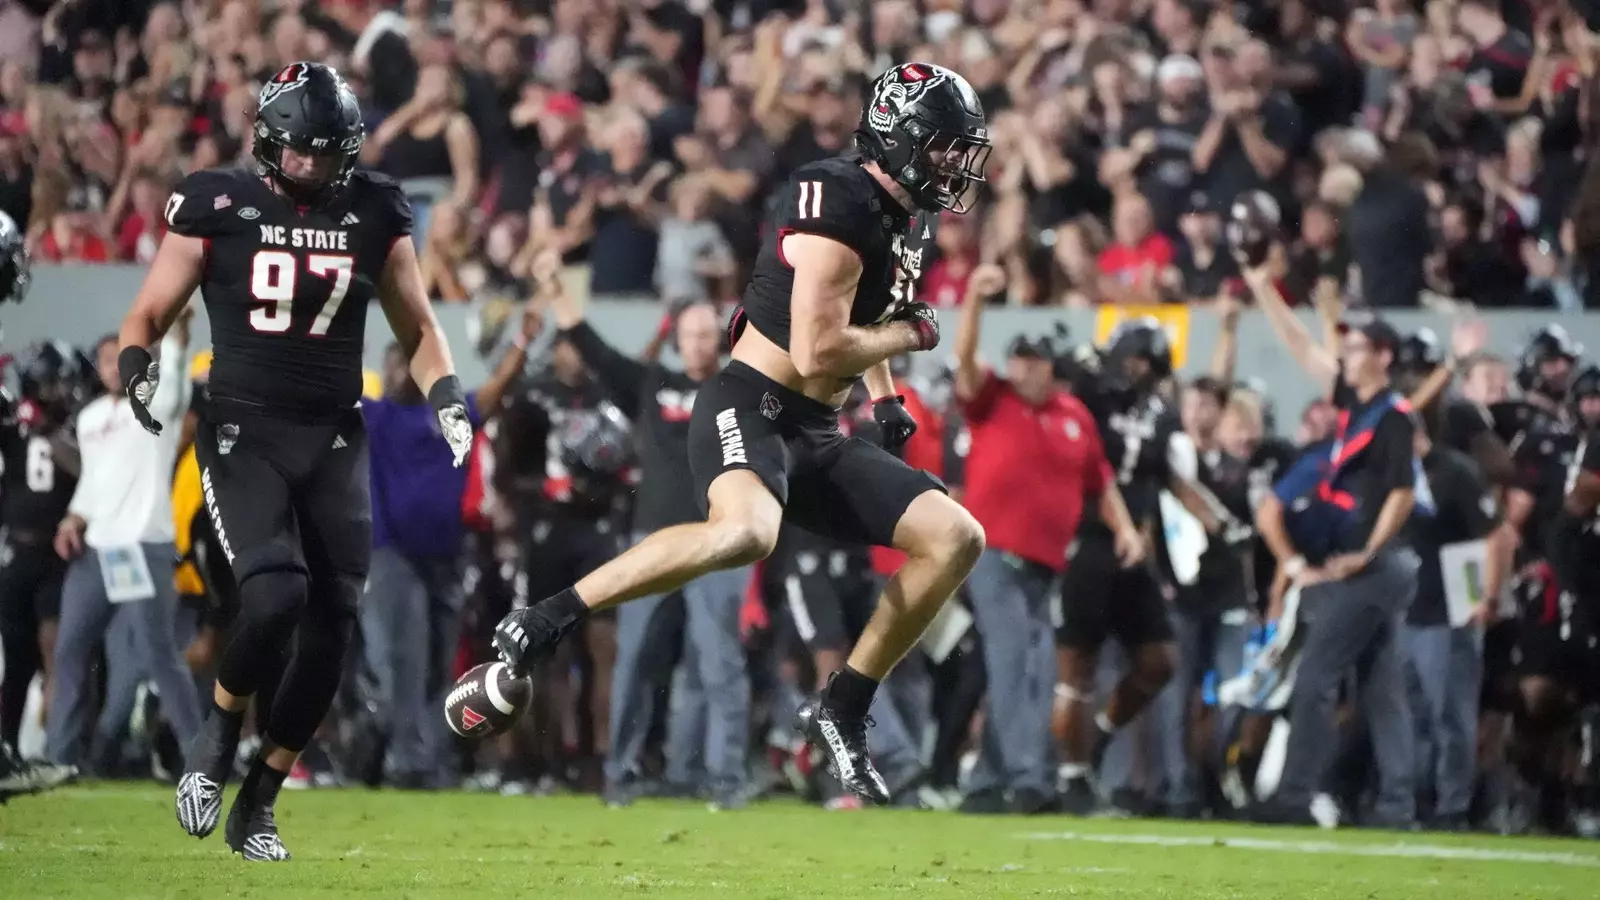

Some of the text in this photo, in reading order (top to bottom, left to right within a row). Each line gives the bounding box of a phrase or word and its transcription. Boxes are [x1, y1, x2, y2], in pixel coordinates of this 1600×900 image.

[798, 181, 823, 219] 11
[259, 224, 348, 250] NC STATE
[249, 250, 354, 336] 97
[26, 435, 55, 493] 6
[715, 407, 748, 467] WOLFPACK
[202, 466, 236, 566] WOLFPACK
